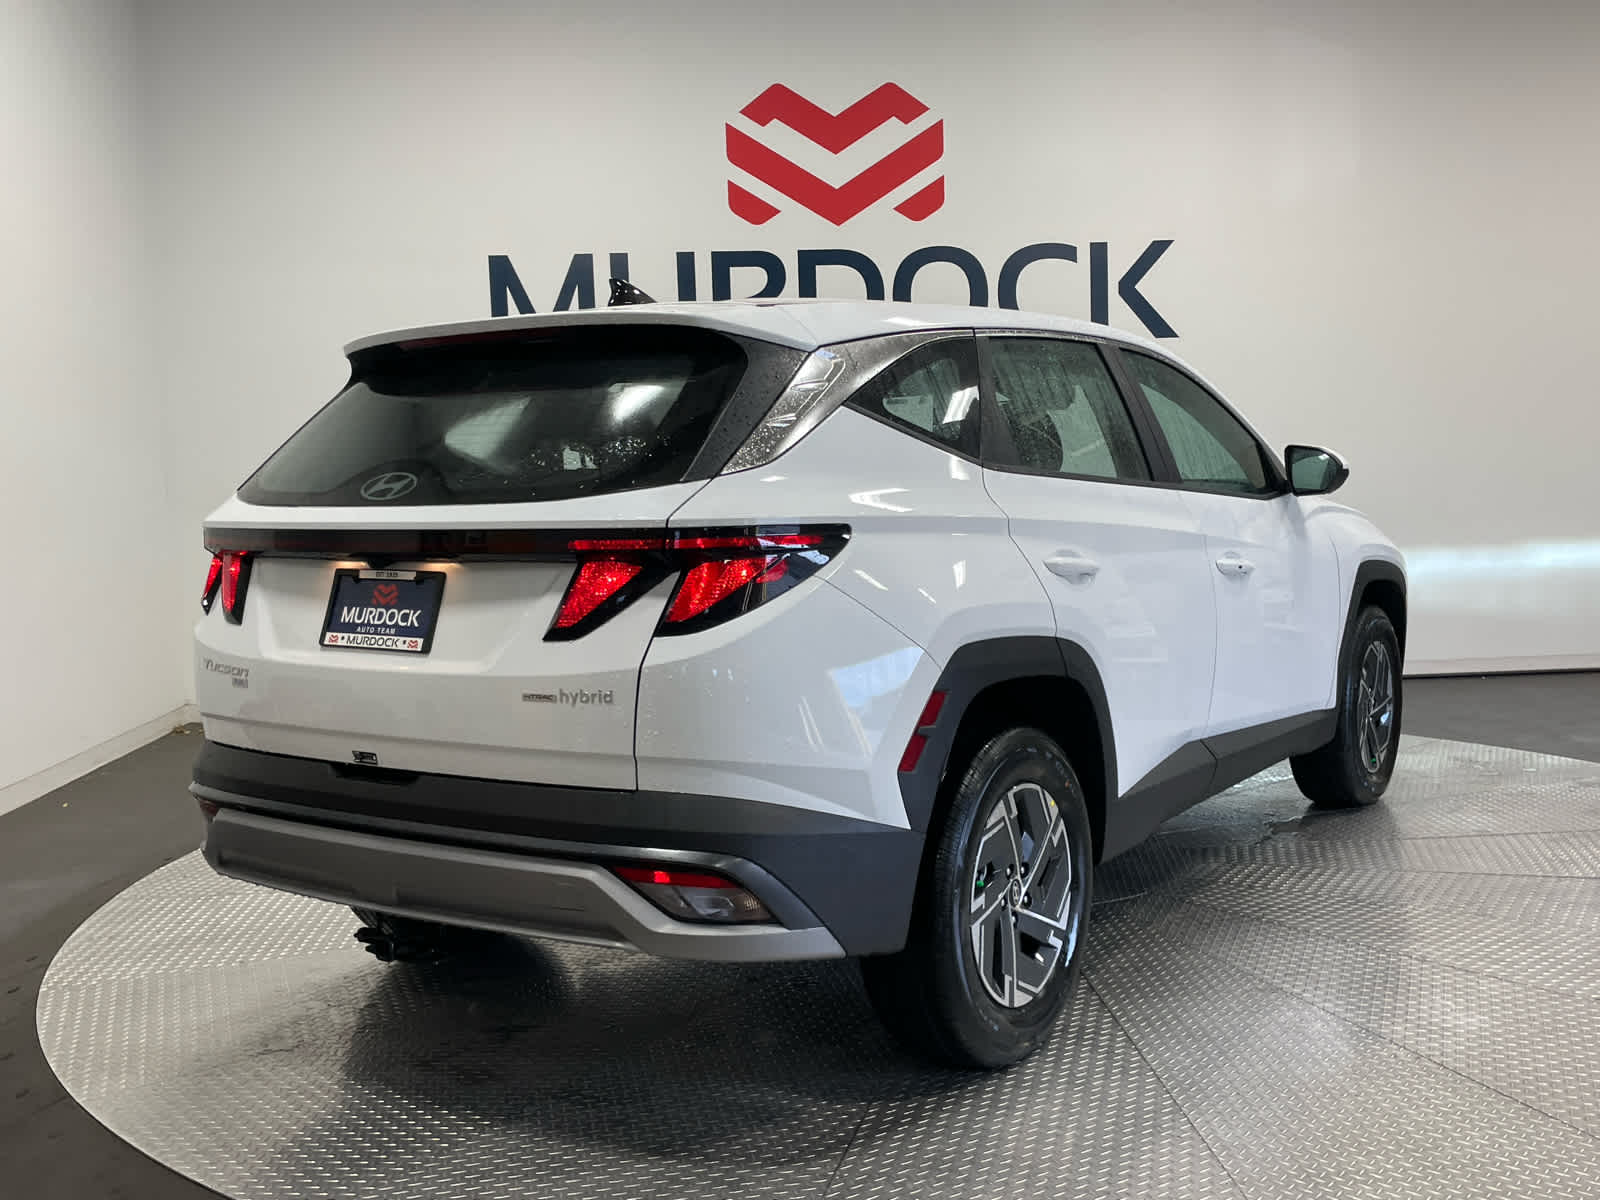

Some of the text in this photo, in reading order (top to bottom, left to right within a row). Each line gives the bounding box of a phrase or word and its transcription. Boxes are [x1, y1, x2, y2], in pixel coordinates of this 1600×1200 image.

[340, 606, 422, 627] MURDOCK
[356, 626, 396, 635] AUTO TEAM
[346, 635, 400, 648] MURDOCK
[559, 687, 613, 708] hybrid
